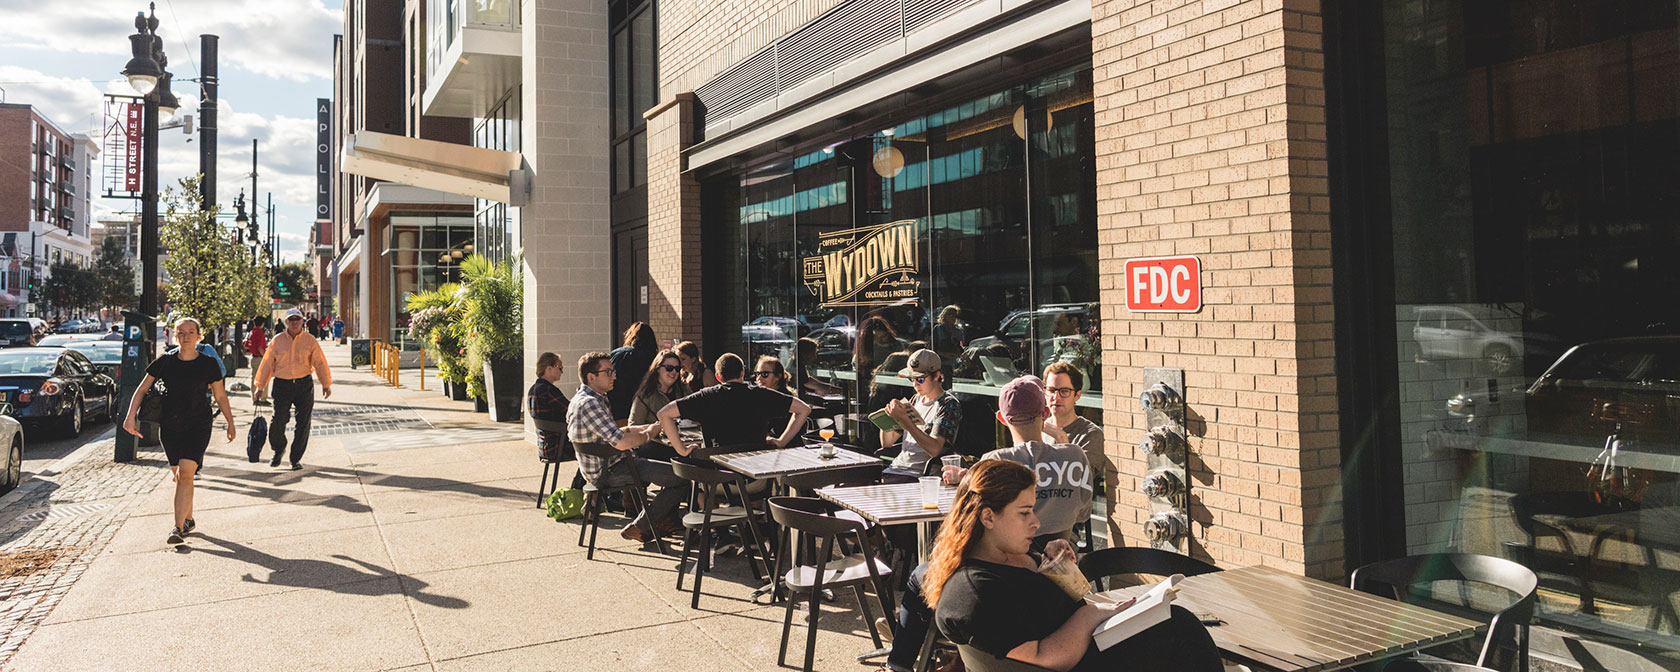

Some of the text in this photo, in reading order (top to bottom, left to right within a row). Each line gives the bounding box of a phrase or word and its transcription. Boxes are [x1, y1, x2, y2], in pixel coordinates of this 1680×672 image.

[130, 120, 138, 137] N.E.
[128, 140, 137, 174] STREET
[318, 105, 329, 214] APOLLO
[822, 238, 838, 247] COFFEE
[806, 225, 914, 299] THE WYDOWN
[864, 290, 889, 298] COCKTAILS
[893, 289, 914, 297] PASTRIES
[1133, 264, 1191, 304] FDC
[129, 326, 140, 339] P
[1034, 461, 1093, 492] CYCL
